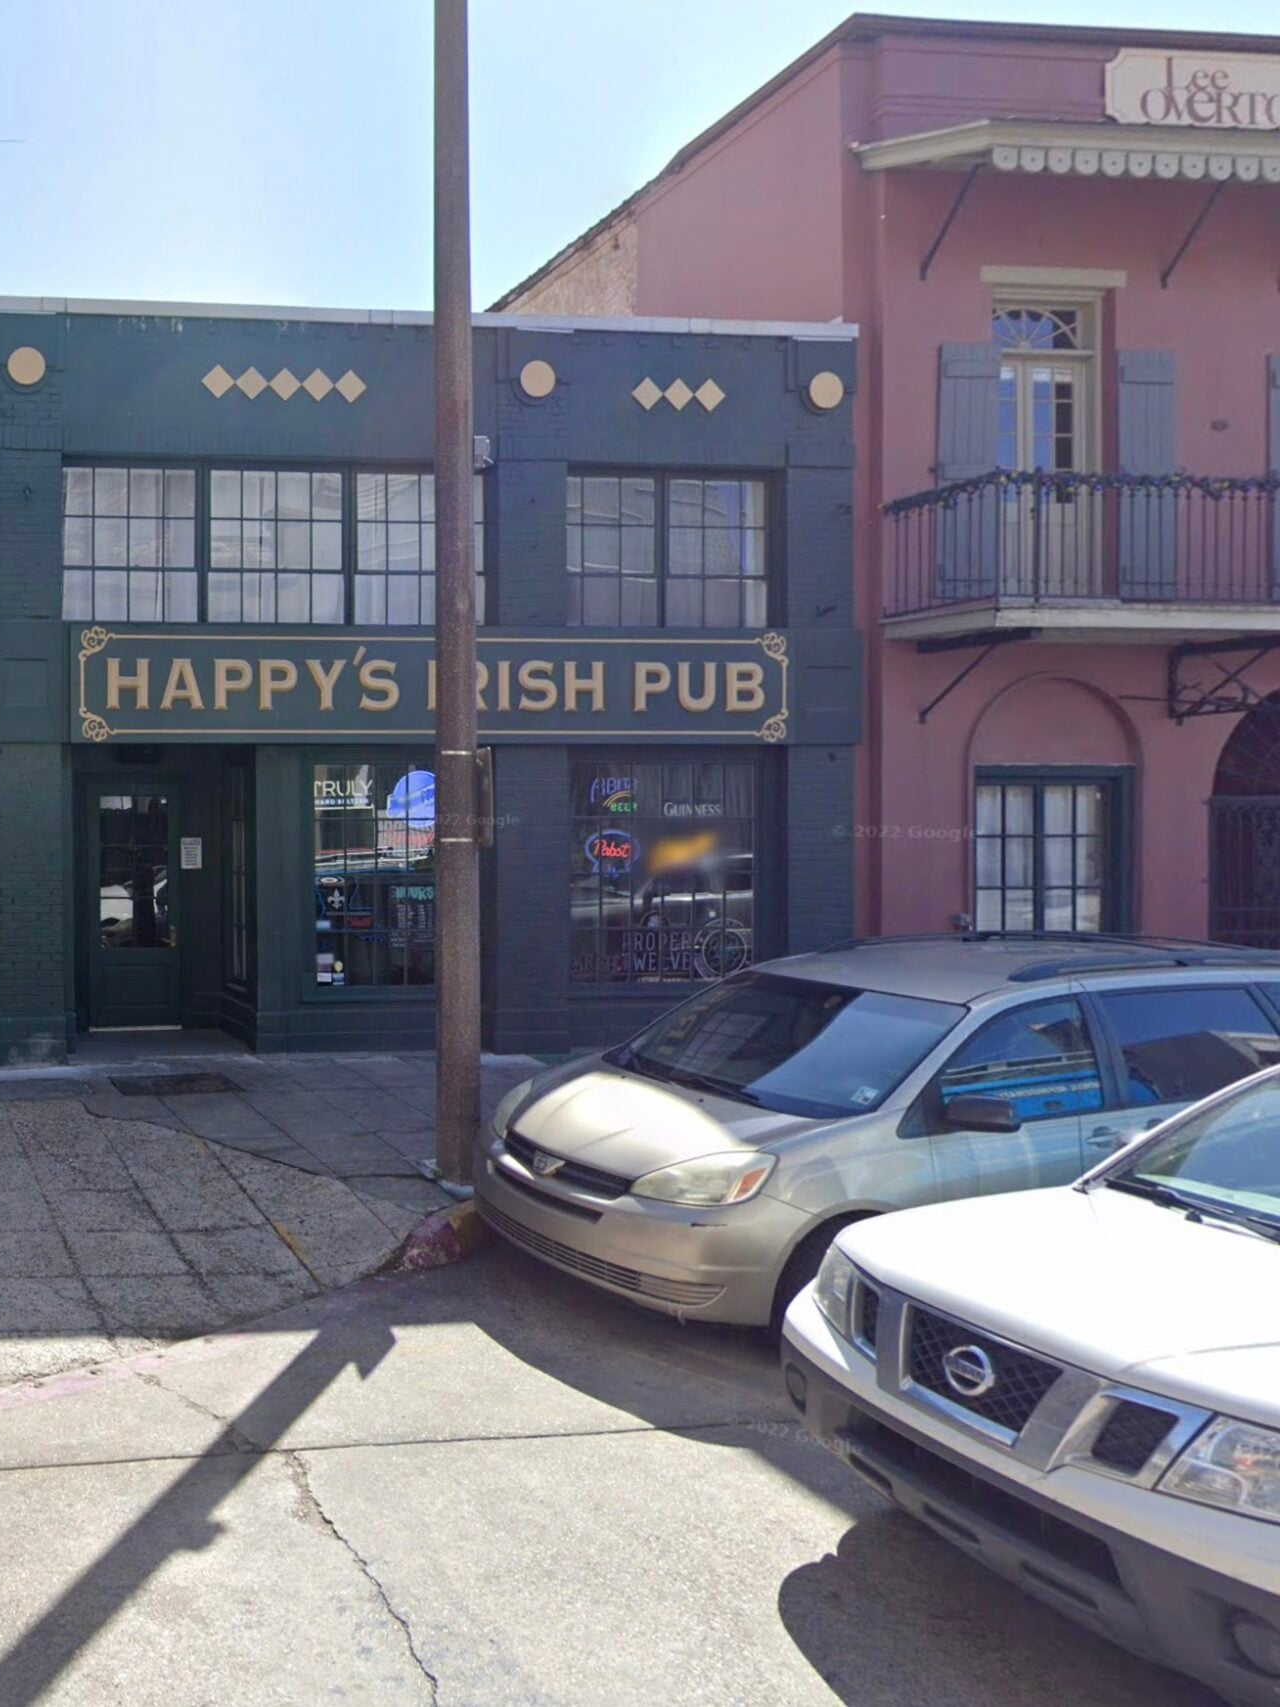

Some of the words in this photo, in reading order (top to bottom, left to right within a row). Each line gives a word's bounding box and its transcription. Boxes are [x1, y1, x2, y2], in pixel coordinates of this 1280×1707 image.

[1163, 56, 1230, 91] Lee
[105, 646, 401, 712] HAPPY'S
[633, 662, 768, 713] PUB
[314, 779, 373, 797] TRULY
[609, 802, 638, 813] BEER
[663, 802, 724, 817] GUINNESS
[593, 839, 631, 858] Pabst
